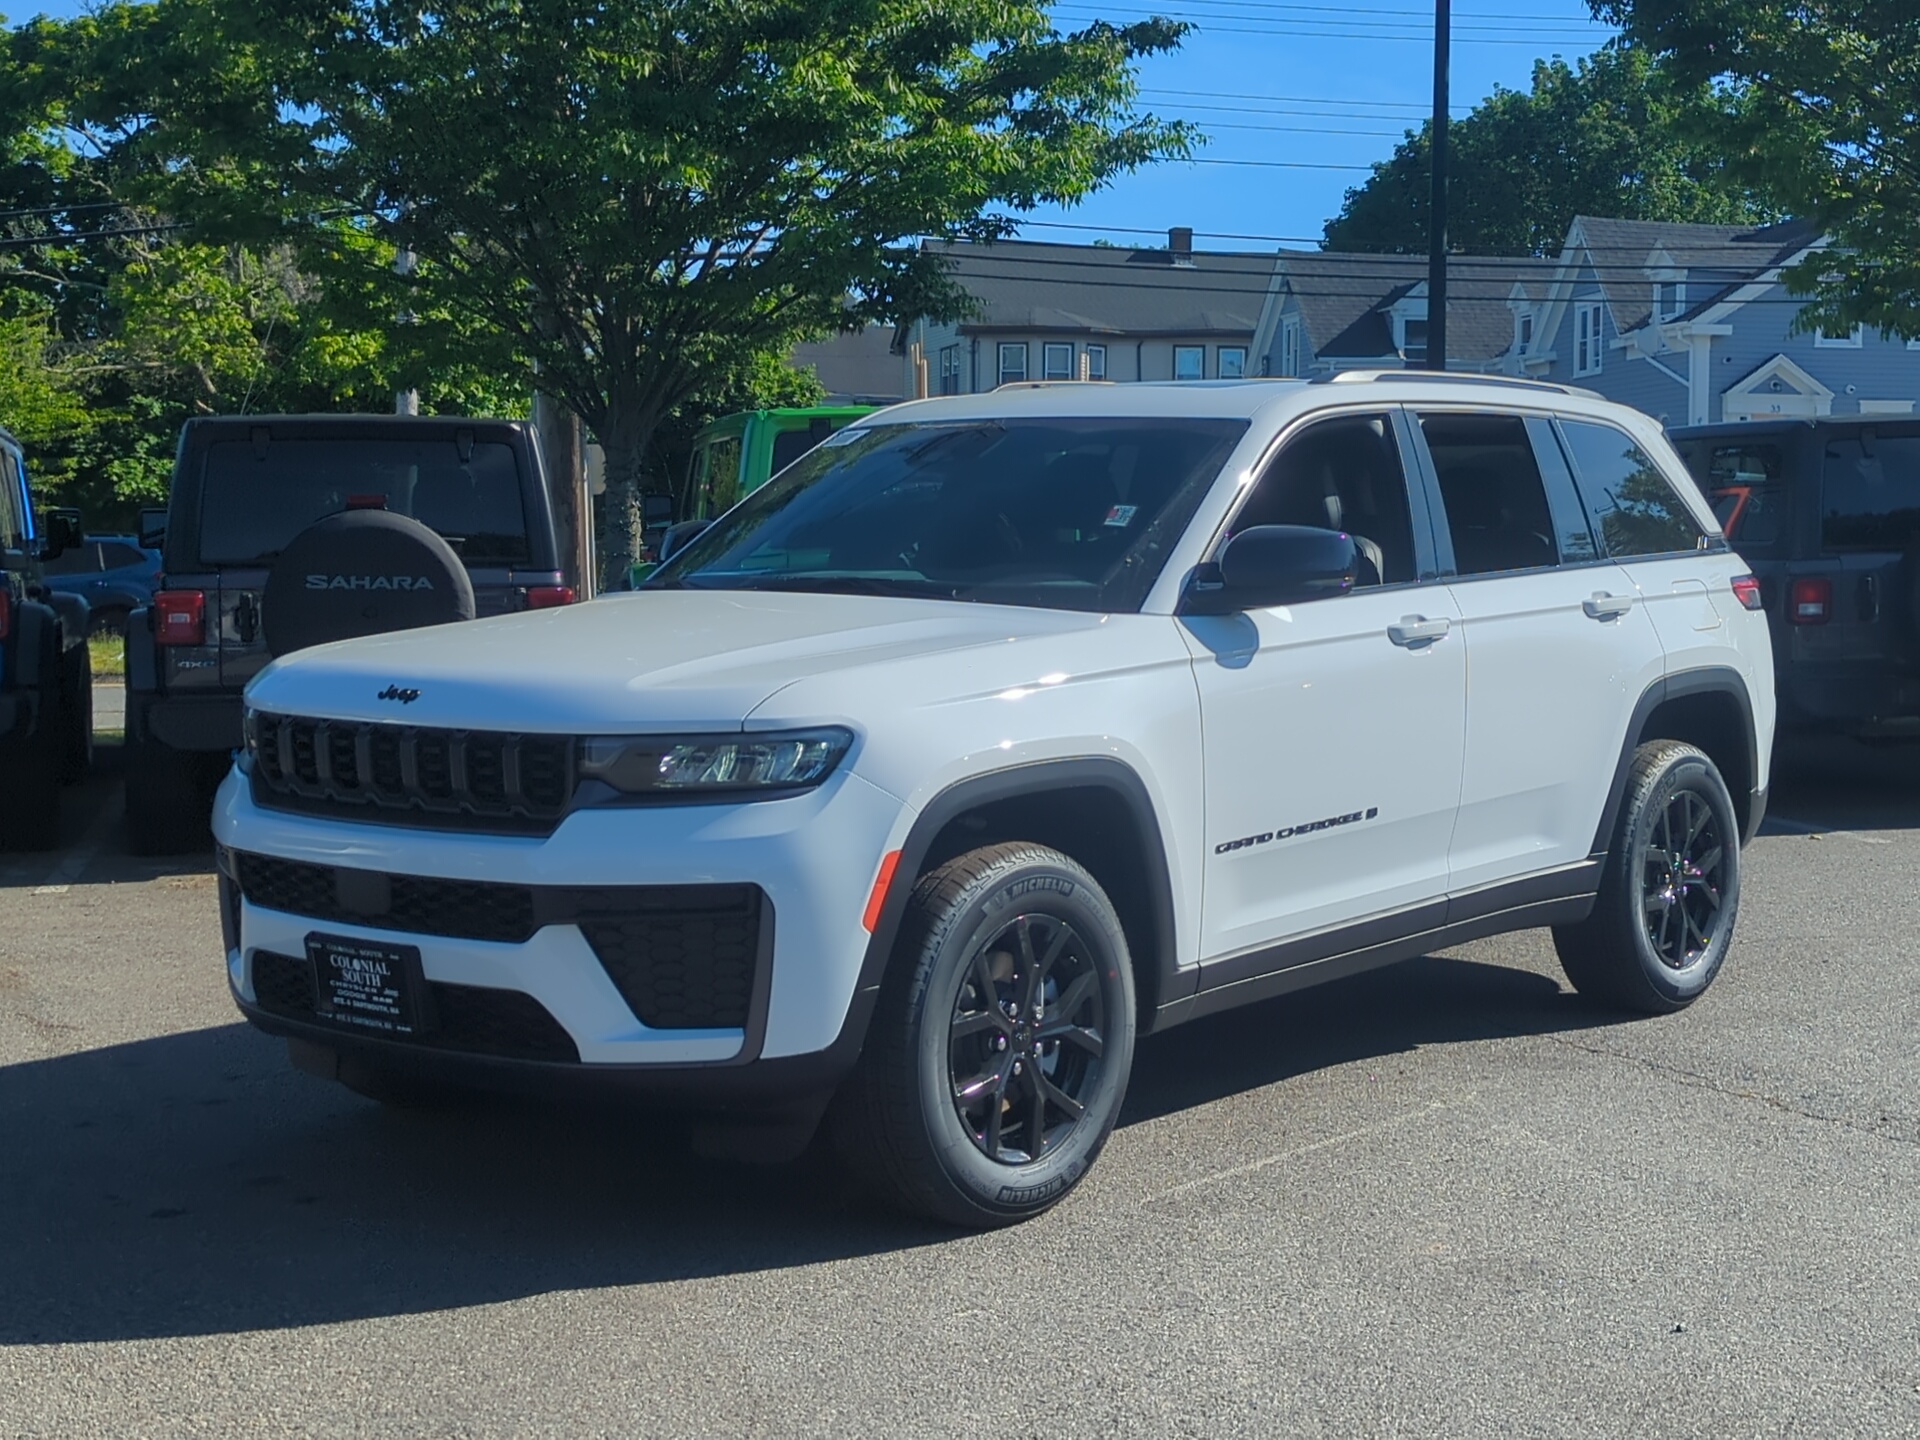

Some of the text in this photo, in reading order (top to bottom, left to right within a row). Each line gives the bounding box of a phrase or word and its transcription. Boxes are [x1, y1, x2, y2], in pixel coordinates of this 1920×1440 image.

[305, 575, 434, 590] SAHARA
[377, 684, 421, 704] Jeep
[1215, 810, 1363, 854] GRAND CHEROKEE
[1011, 878, 1073, 897] MICHELIN
[330, 954, 390, 975] COLONIAL
[329, 980, 377, 993] CHRYSLER
[342, 969, 381, 987] SOUTH
[337, 989, 366, 1000] DODGE
[1000, 1179, 1062, 1201] MICHELIN
